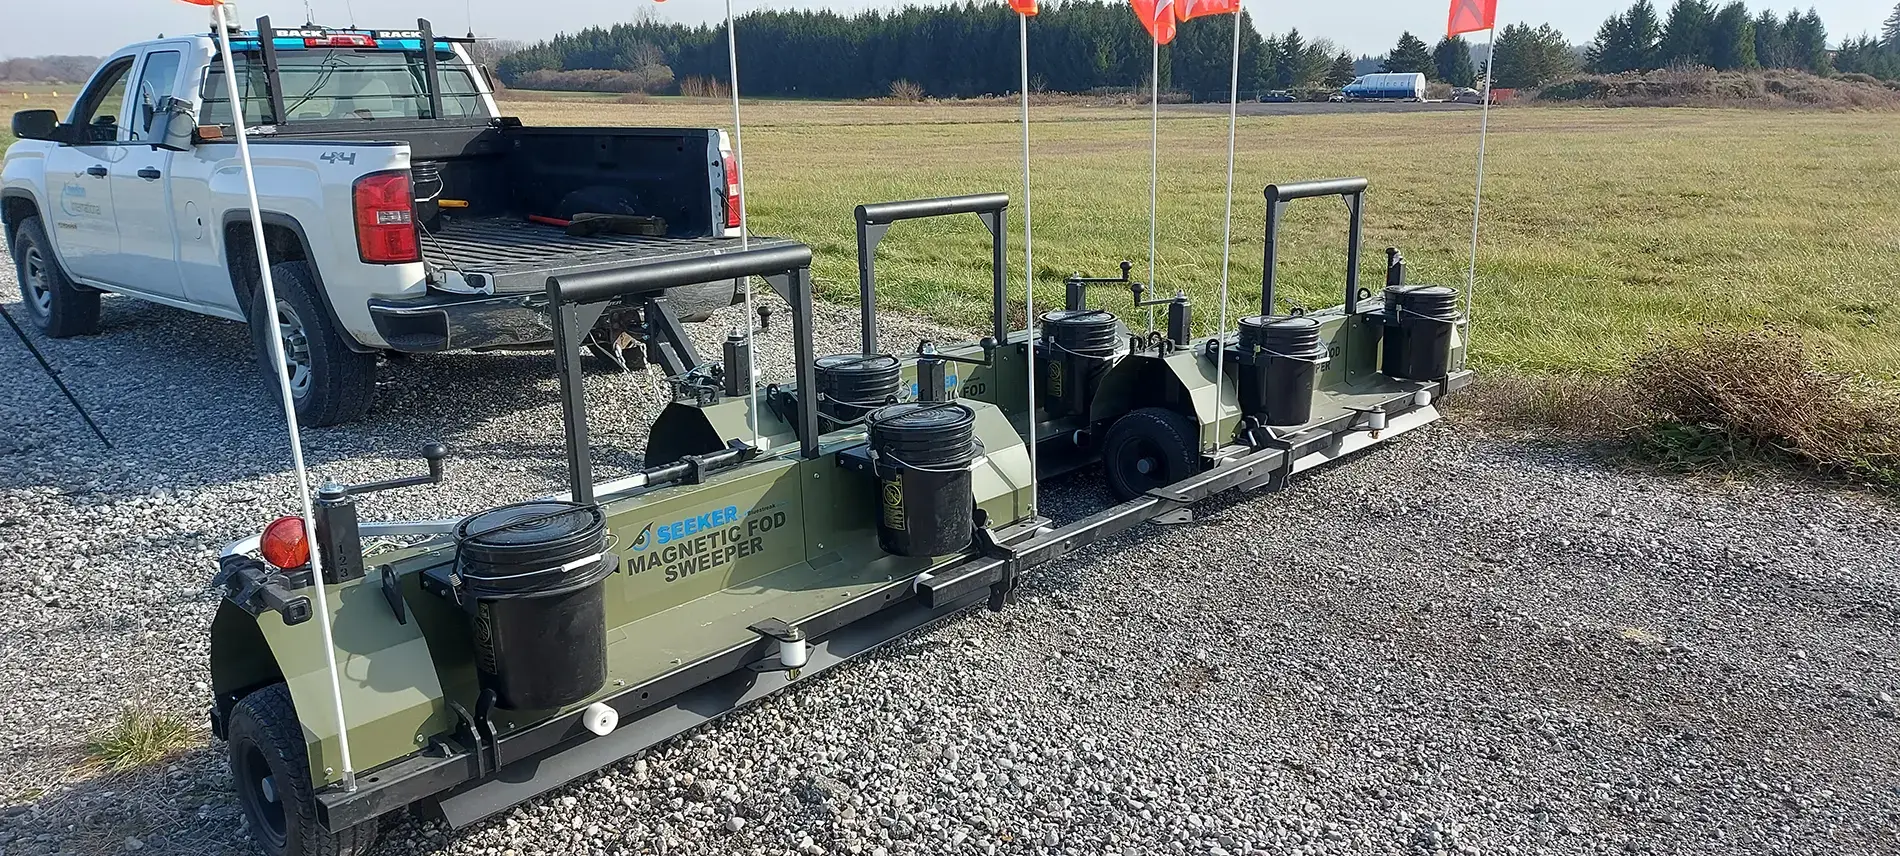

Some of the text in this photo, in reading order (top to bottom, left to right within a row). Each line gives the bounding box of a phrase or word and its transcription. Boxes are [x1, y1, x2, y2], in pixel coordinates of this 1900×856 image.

[276, 29, 323, 37] BACK
[963, 382, 986, 397] FOD
[656, 505, 738, 544] SEEKER
[627, 511, 786, 576] MAGNETIC FOD
[339, 556, 347, 566] 2
[664, 537, 764, 583] SWEEPER
[340, 568, 349, 578] 3
